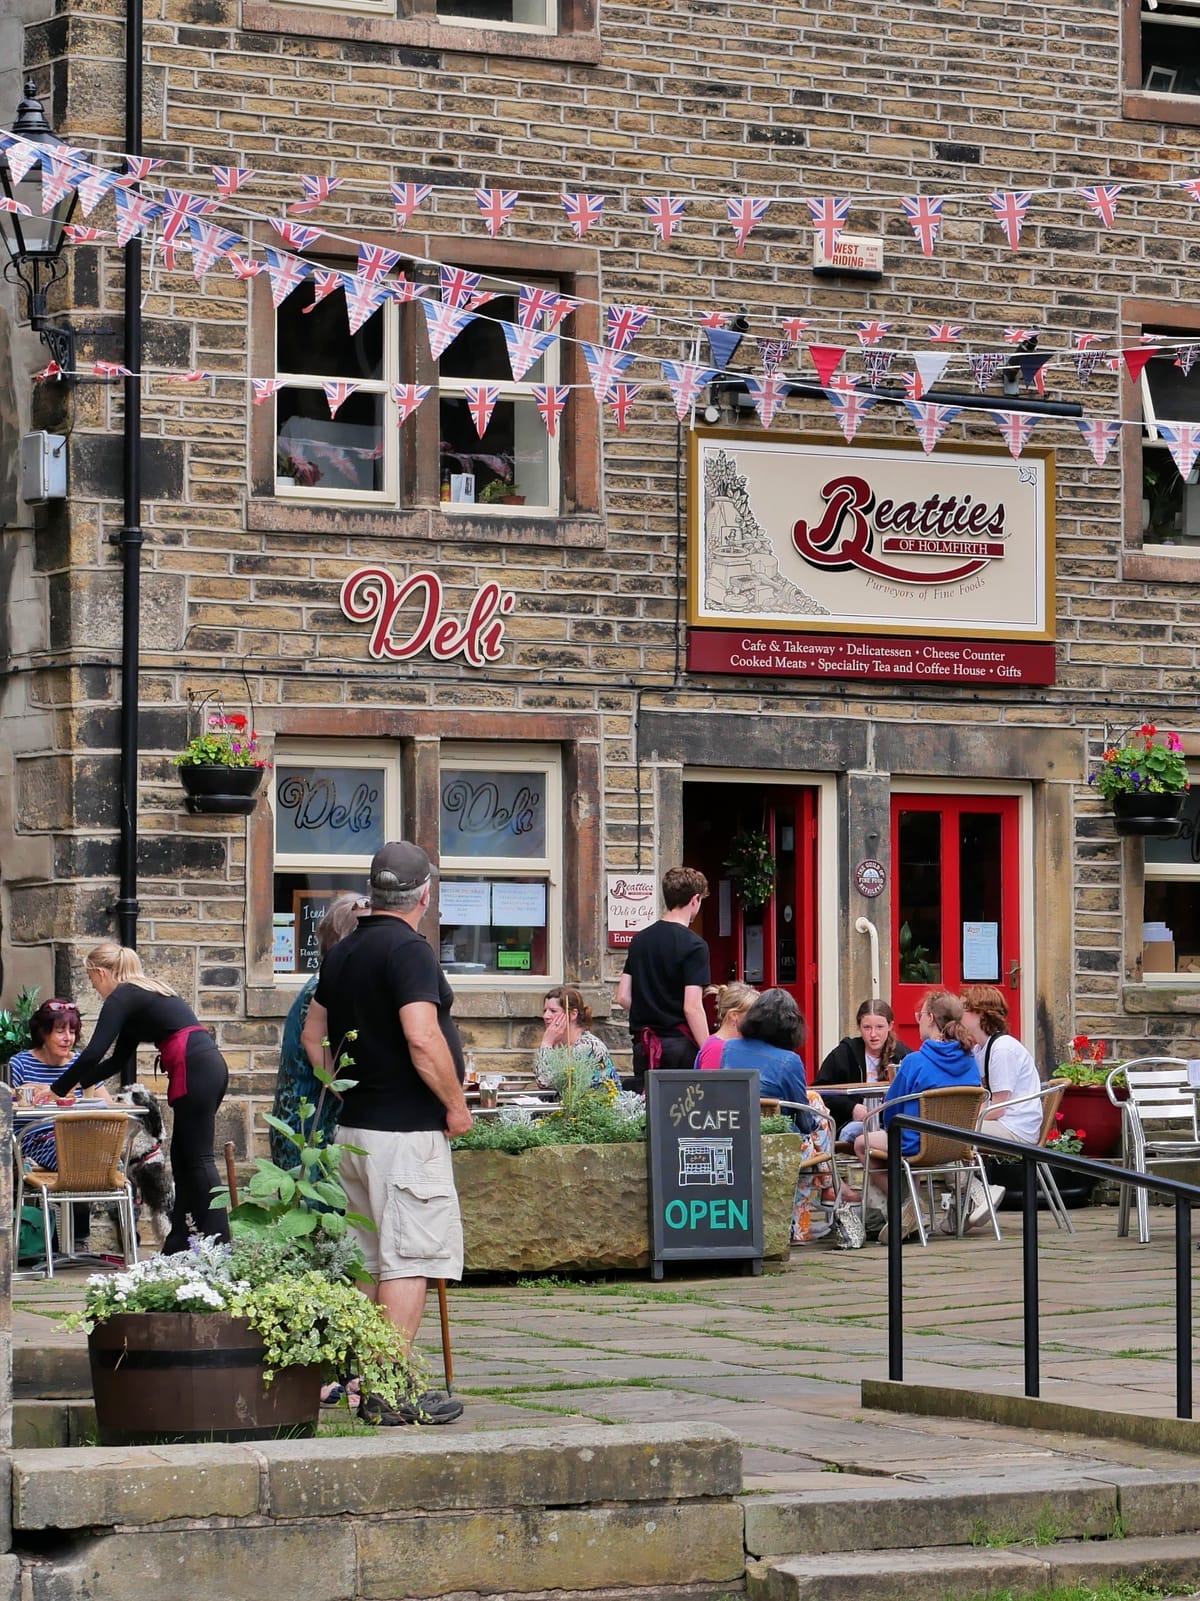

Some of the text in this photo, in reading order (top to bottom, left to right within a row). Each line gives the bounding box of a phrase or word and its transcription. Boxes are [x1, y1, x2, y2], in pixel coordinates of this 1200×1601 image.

[834, 244, 859, 255] WEST
[832, 255, 864, 267] RIDING
[791, 475, 1006, 584] Beatties
[899, 539, 988, 555] OF HOLMFIRTH
[865, 576, 986, 600] Purveyors of Fine Foods
[340, 565, 516, 667] Deli
[741, 639, 1005, 661] Cafe & Takeaway Delicatessen Cheese Counter
[730, 656, 1022, 678] Cooked Meats Speciality Tea and Coffee House Gifts
[277, 776, 378, 833] Deli
[442, 779, 540, 835] Deli
[610, 880, 653, 901] Beatties
[303, 905, 325, 920] Iced
[610, 904, 629, 916] Deli
[638, 905, 654, 920] Cafe
[614, 933, 633, 943] Entr
[669, 1083, 704, 1127] Sid's
[688, 1110, 741, 1130] CAFE
[665, 1199, 749, 1231] OPEN
